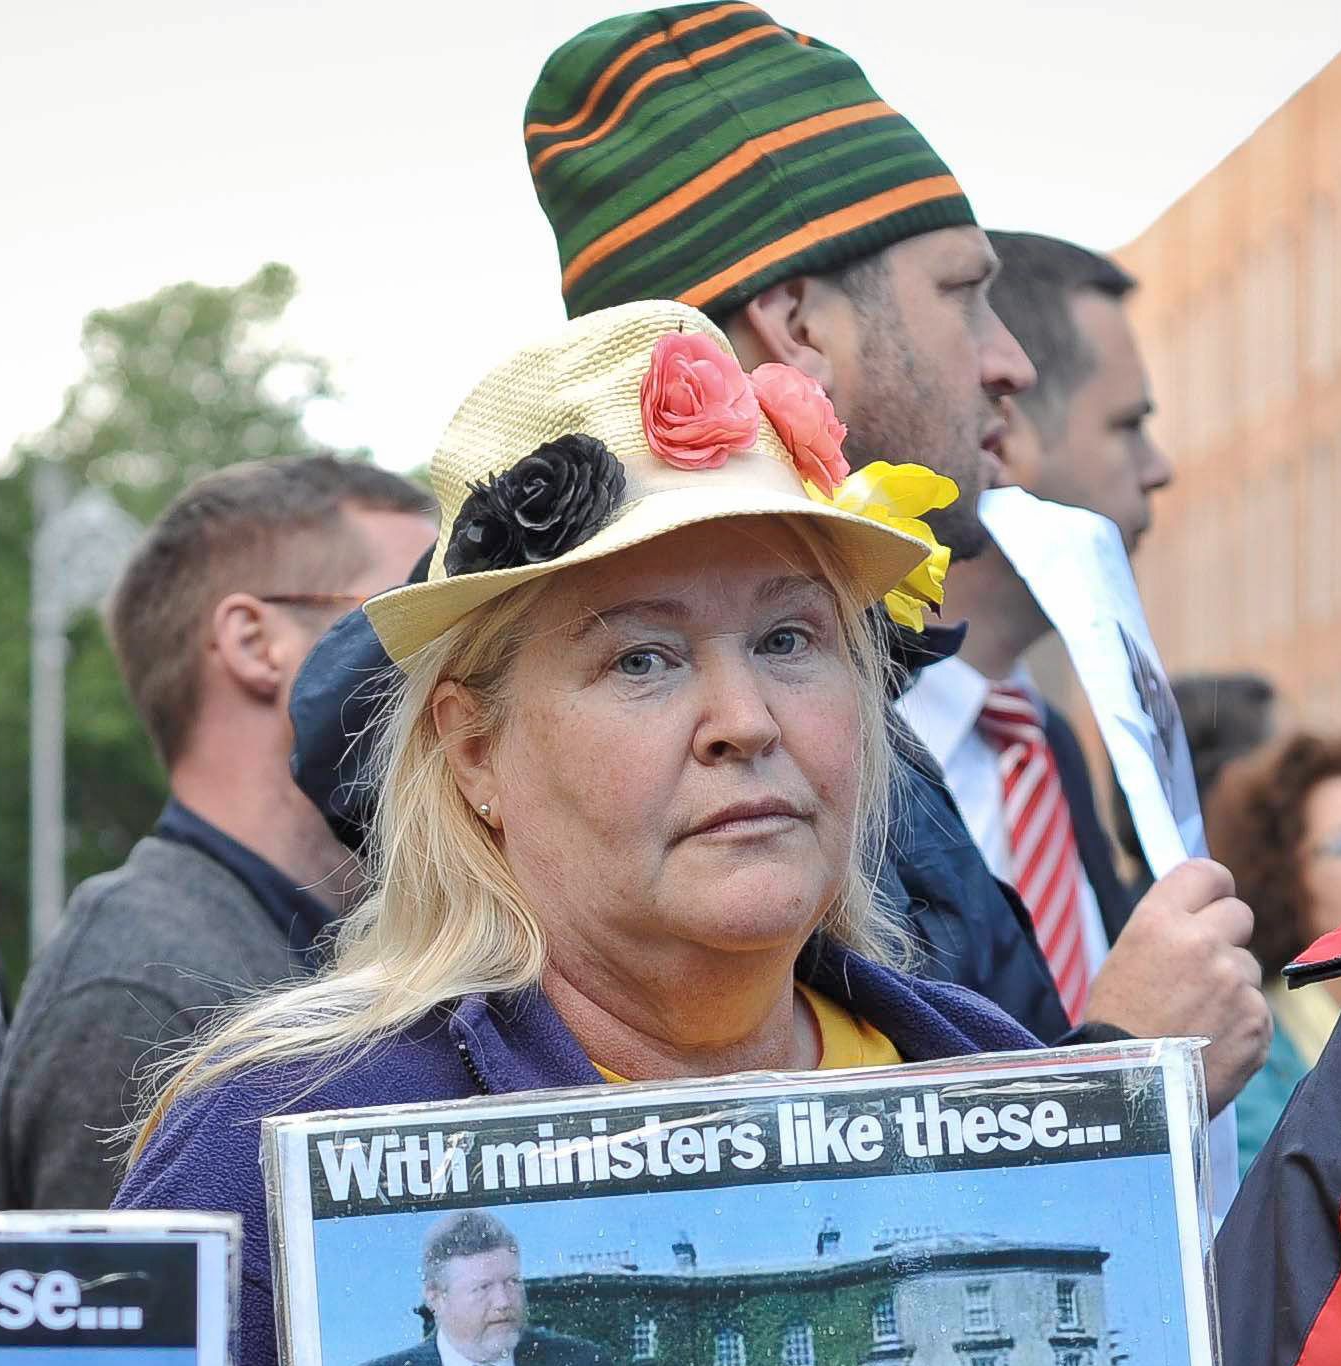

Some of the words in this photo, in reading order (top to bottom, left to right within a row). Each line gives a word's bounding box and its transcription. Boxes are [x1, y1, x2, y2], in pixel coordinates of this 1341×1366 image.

[317, 1128, 469, 1203] With
[481, 1114, 766, 1190] ministers
[777, 1100, 885, 1166] like
[895, 1093, 1122, 1159] these...
